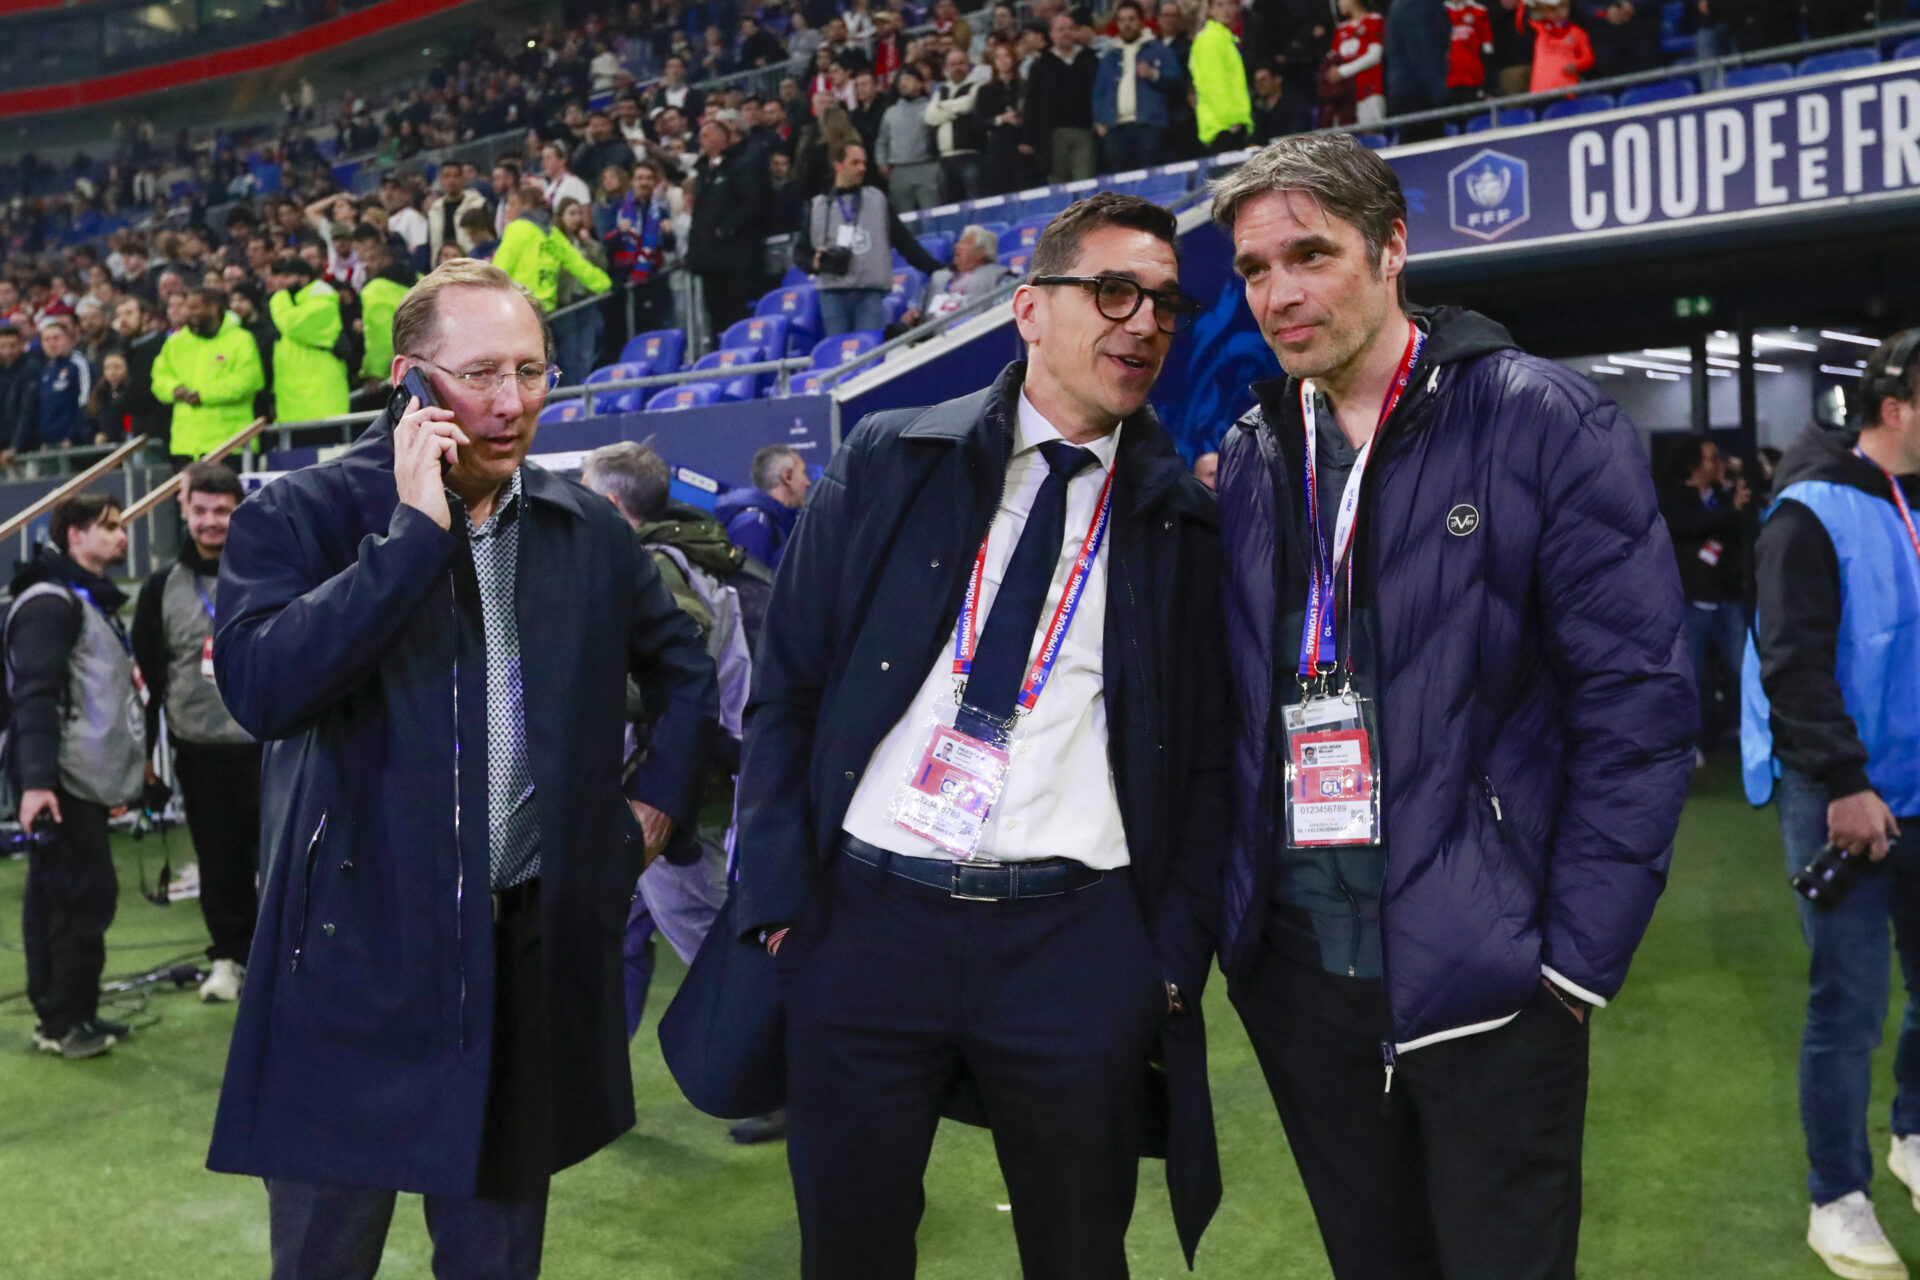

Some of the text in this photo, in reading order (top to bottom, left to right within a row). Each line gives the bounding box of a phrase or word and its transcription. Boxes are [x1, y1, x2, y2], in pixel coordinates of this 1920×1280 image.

[1568, 99, 1789, 231] COUPE
[1467, 207, 1511, 228] FFF
[1087, 510, 1106, 552] OLYMPIQUE
[960, 611, 972, 656] LYONNAIS
[1041, 573, 1083, 663] OLYMPIQUE LYONNAIS
[1306, 607, 1319, 655] LYONNAIS
[1031, 672, 1043, 683] OL
[1322, 781, 1340, 793] OL
[914, 796, 960, 819] 12346789
[1300, 804, 1347, 815] 0123456789
